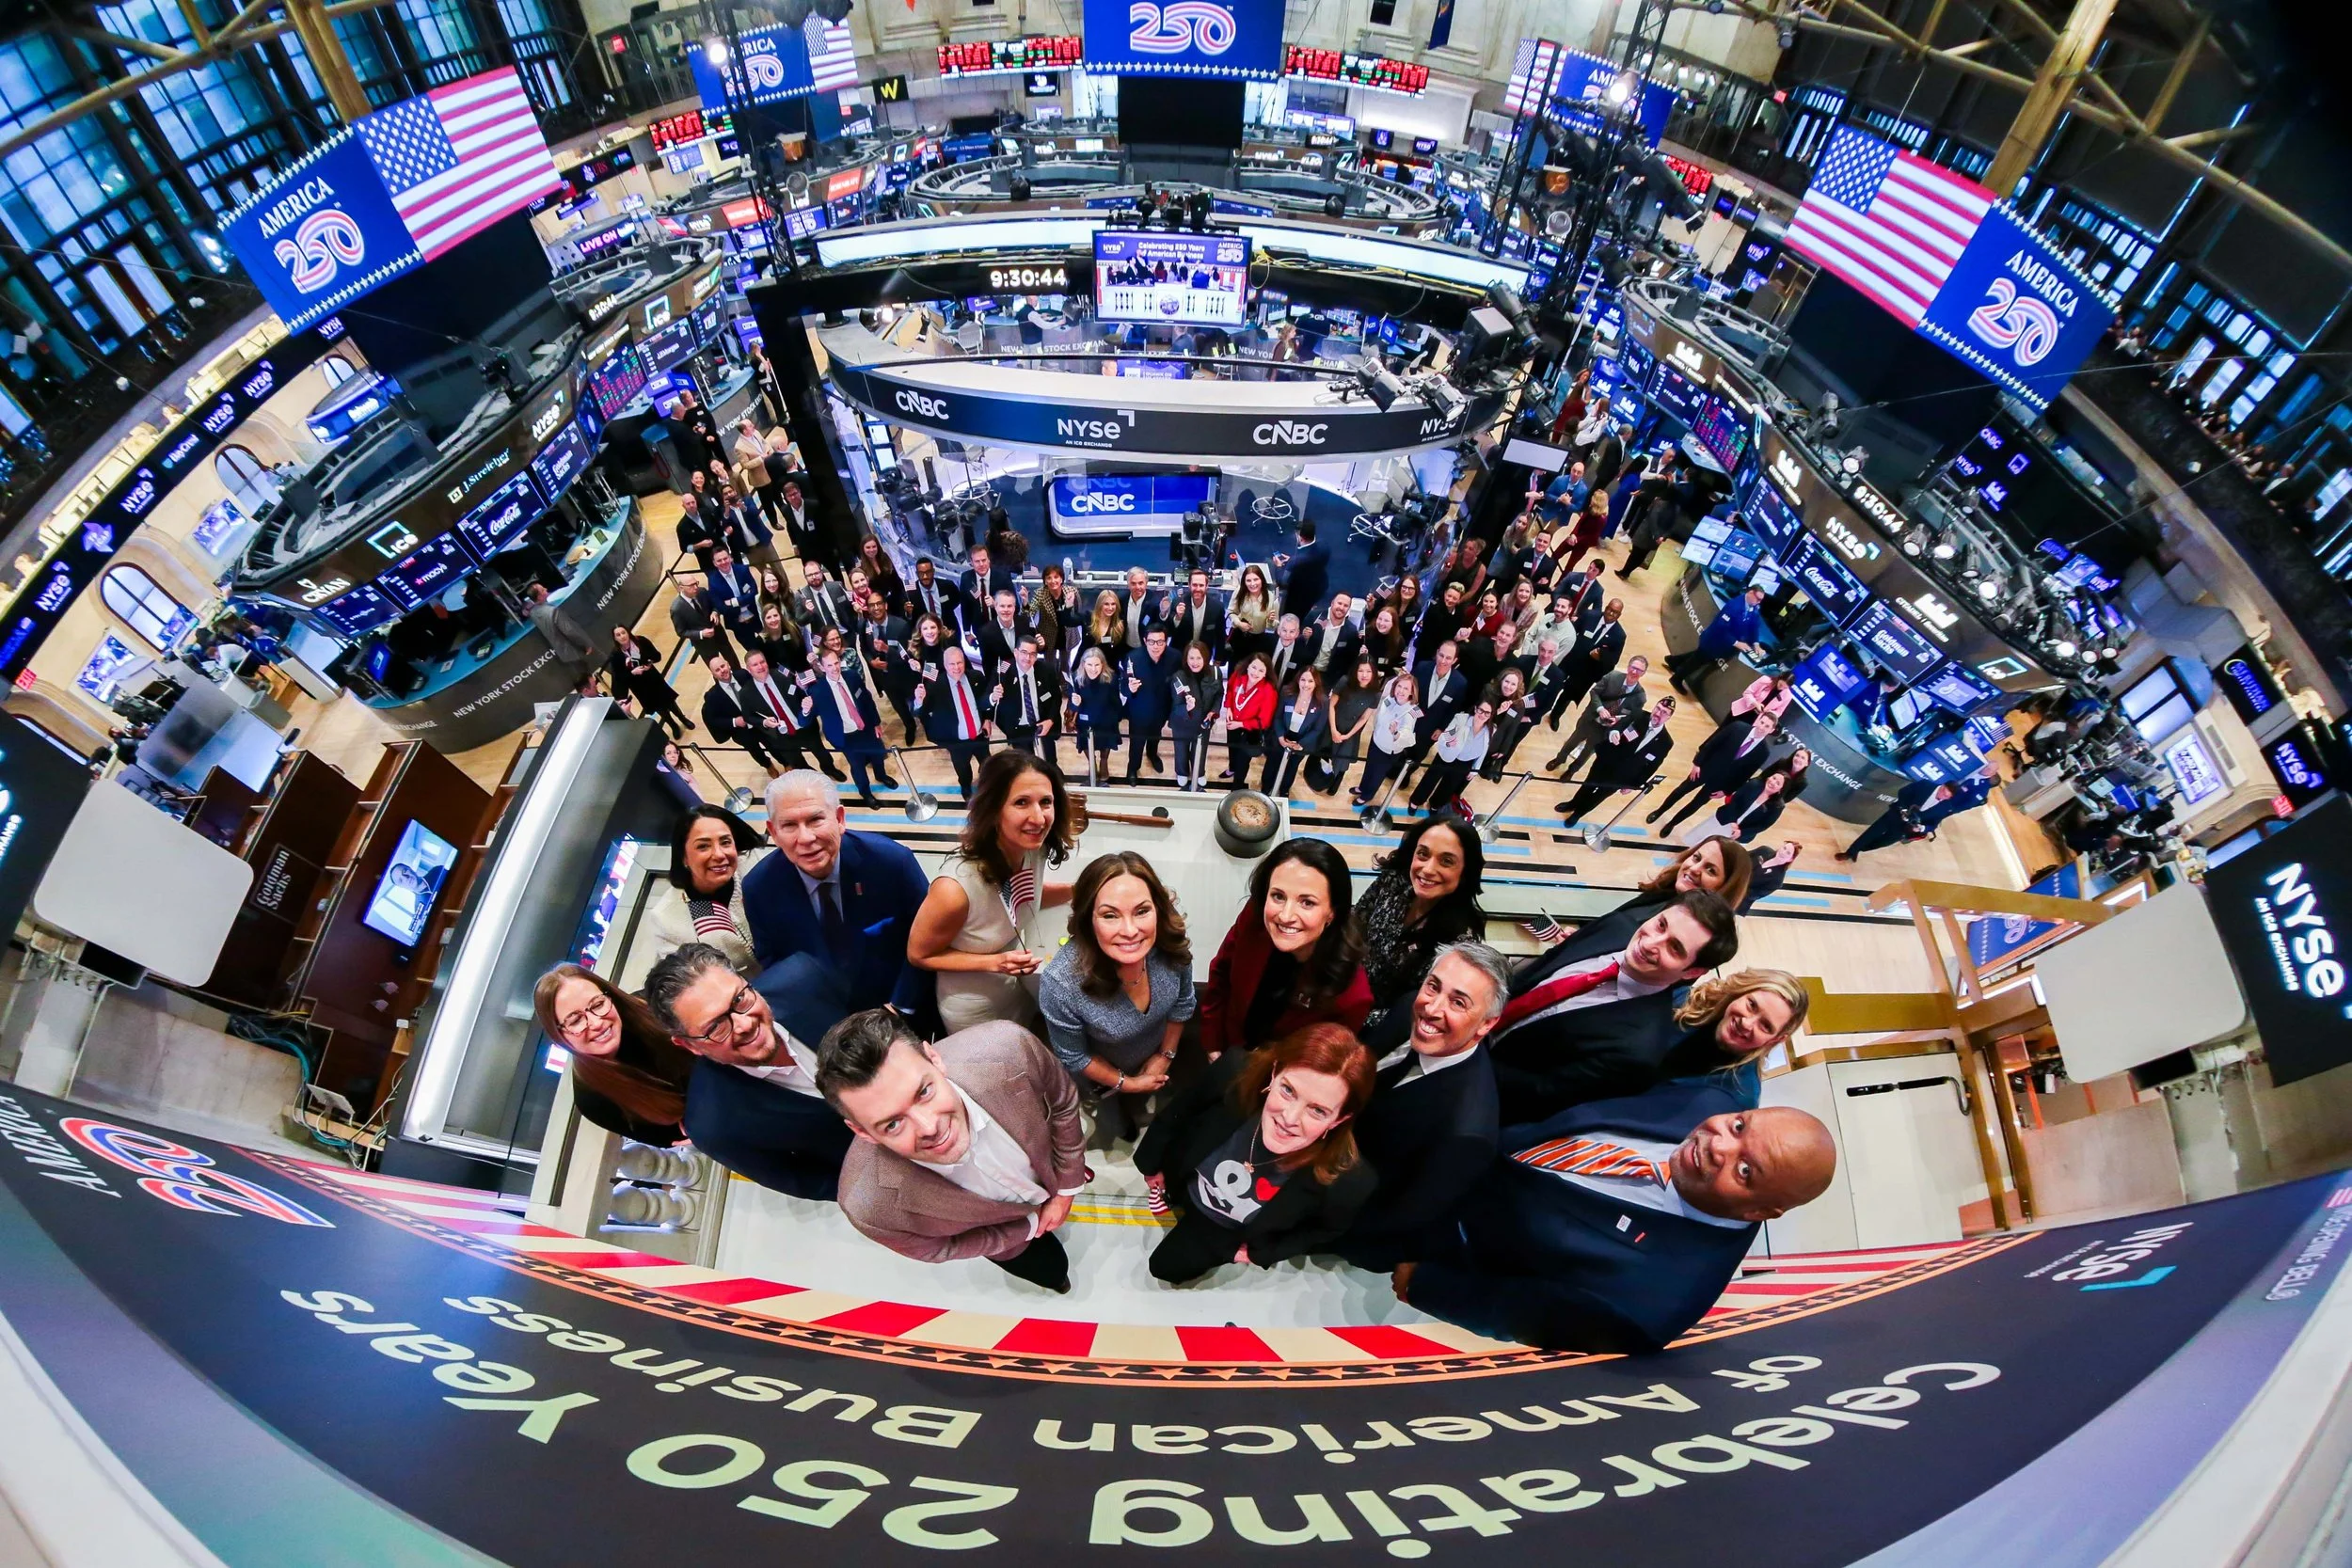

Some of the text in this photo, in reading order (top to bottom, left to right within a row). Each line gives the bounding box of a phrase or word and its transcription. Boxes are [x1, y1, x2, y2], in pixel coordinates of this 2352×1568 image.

[1130, 1, 1236, 55] 250
[881, 79, 898, 100] W
[259, 176, 335, 239] AMERICA
[274, 209, 365, 293] 250
[580, 230, 618, 254] LIVE ON
[1138, 242, 1173, 251] Celebrating
[1188, 244, 1205, 252] Years
[1216, 249, 1244, 261] 250
[990, 268, 1067, 289] 9:30:44
[2005, 249, 2079, 318] AMERICA
[1967, 277, 2059, 367] 250
[1044, 344, 1071, 353] STOCK
[896, 390, 949, 420] CNBC
[1253, 420, 1327, 444] CNBC
[551, 450, 573, 475] Goldman
[1072, 492, 1135, 512] CNBC
[1854, 486, 1904, 534] 9:30:44
[596, 546, 642, 610] NEW YORK STOCK
[1685, 601, 1700, 628] STOCK
[1872, 639, 1897, 657] Sachs
[1877, 629, 1909, 657] Goldman
[453, 703, 476, 718] NEW
[475, 689, 503, 706] YORK
[501, 666, 534, 691] STOCK
[1815, 758, 1863, 790] EXCHANGE
[2274, 796, 2294, 816] EXIT
[257, 850, 290, 905] Goldman
[266, 873, 292, 910] Sachs
[2255, 898, 2271, 912] AN
[58, 1117, 336, 1228] 250
[443, 1295, 1824, 1465] of American Business
[279, 1288, 2002, 1560] Celebrating 250 Years
